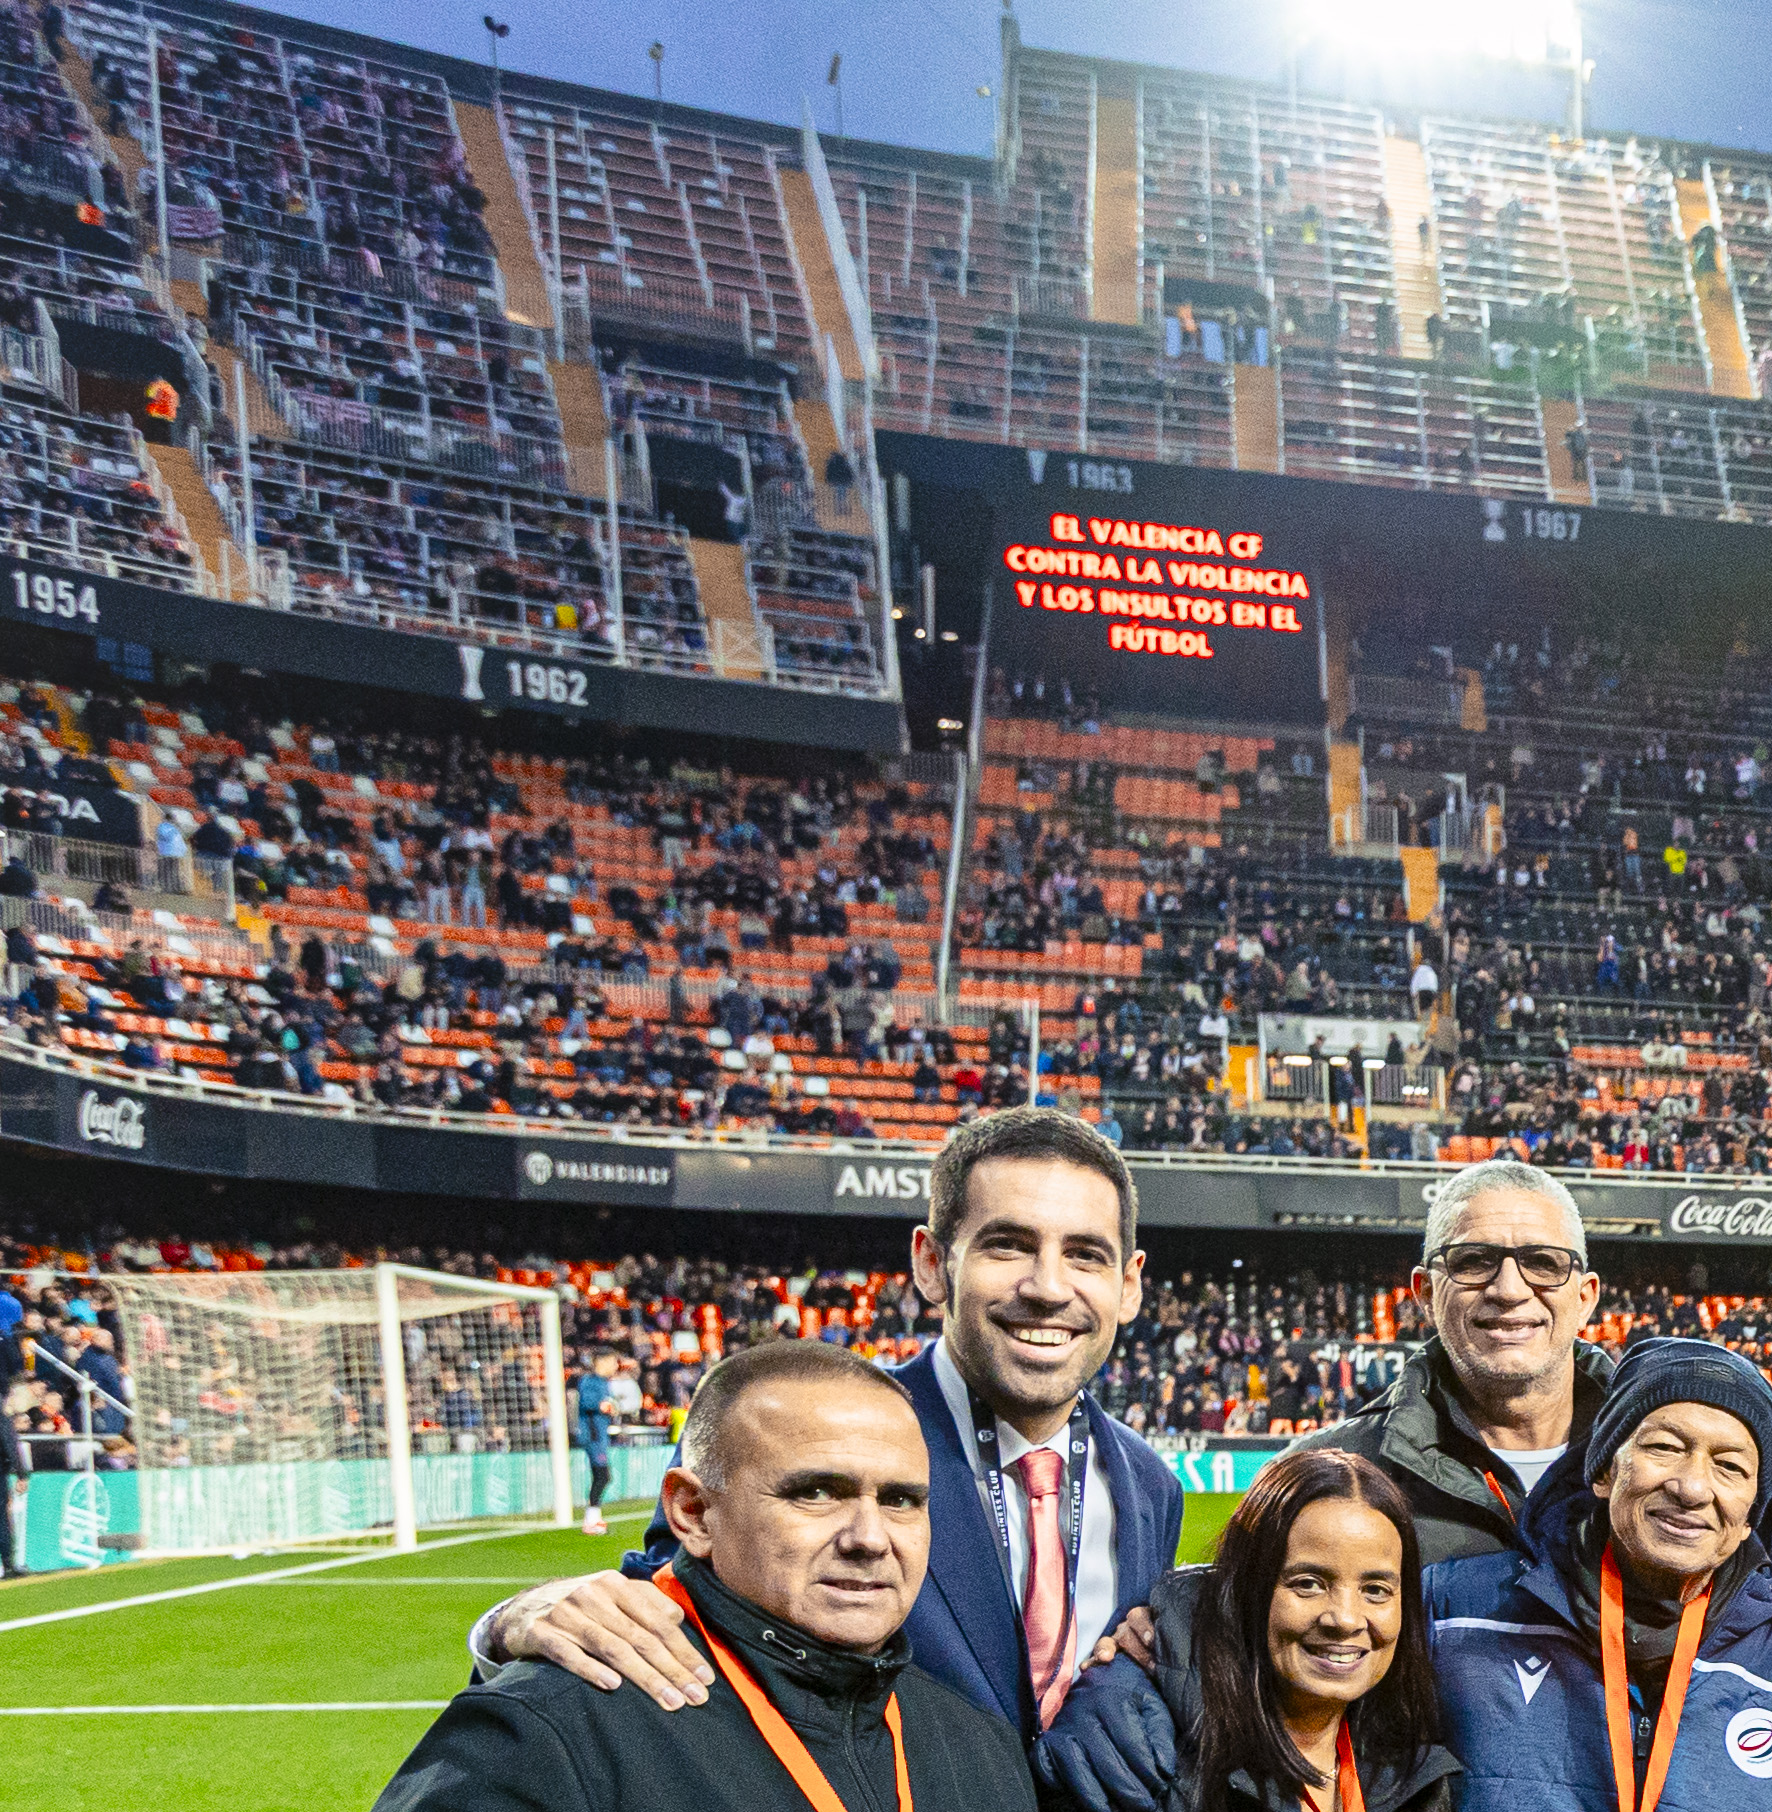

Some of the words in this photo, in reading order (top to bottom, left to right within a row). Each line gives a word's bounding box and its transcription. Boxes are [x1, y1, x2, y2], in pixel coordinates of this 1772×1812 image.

[1067, 461, 1133, 494] 1963
[1050, 512, 1086, 543] EL
[1088, 517, 1224, 556] VALENCIA
[1227, 531, 1263, 560] CF
[1523, 508, 1581, 541] 1967
[1004, 543, 1122, 580] CONTRA
[1124, 555, 1163, 584] LA
[1166, 560, 1309, 599] VIOLENCIA
[13, 571, 101, 624] 1954
[1015, 579, 1037, 607] Y
[1039, 582, 1094, 613] LOS
[1097, 586, 1228, 625] INSULTOS
[1229, 600, 1267, 628] EN
[1269, 604, 1303, 632] EL
[1108, 619, 1214, 659] FÚTBOL
[507, 661, 588, 707] 1962
[79, 1089, 147, 1150] Coca-Cola
[835, 1163, 931, 1200] AMST
[988, 1469, 1001, 1497] CLUB
[1073, 1480, 1081, 1499] CLUB
